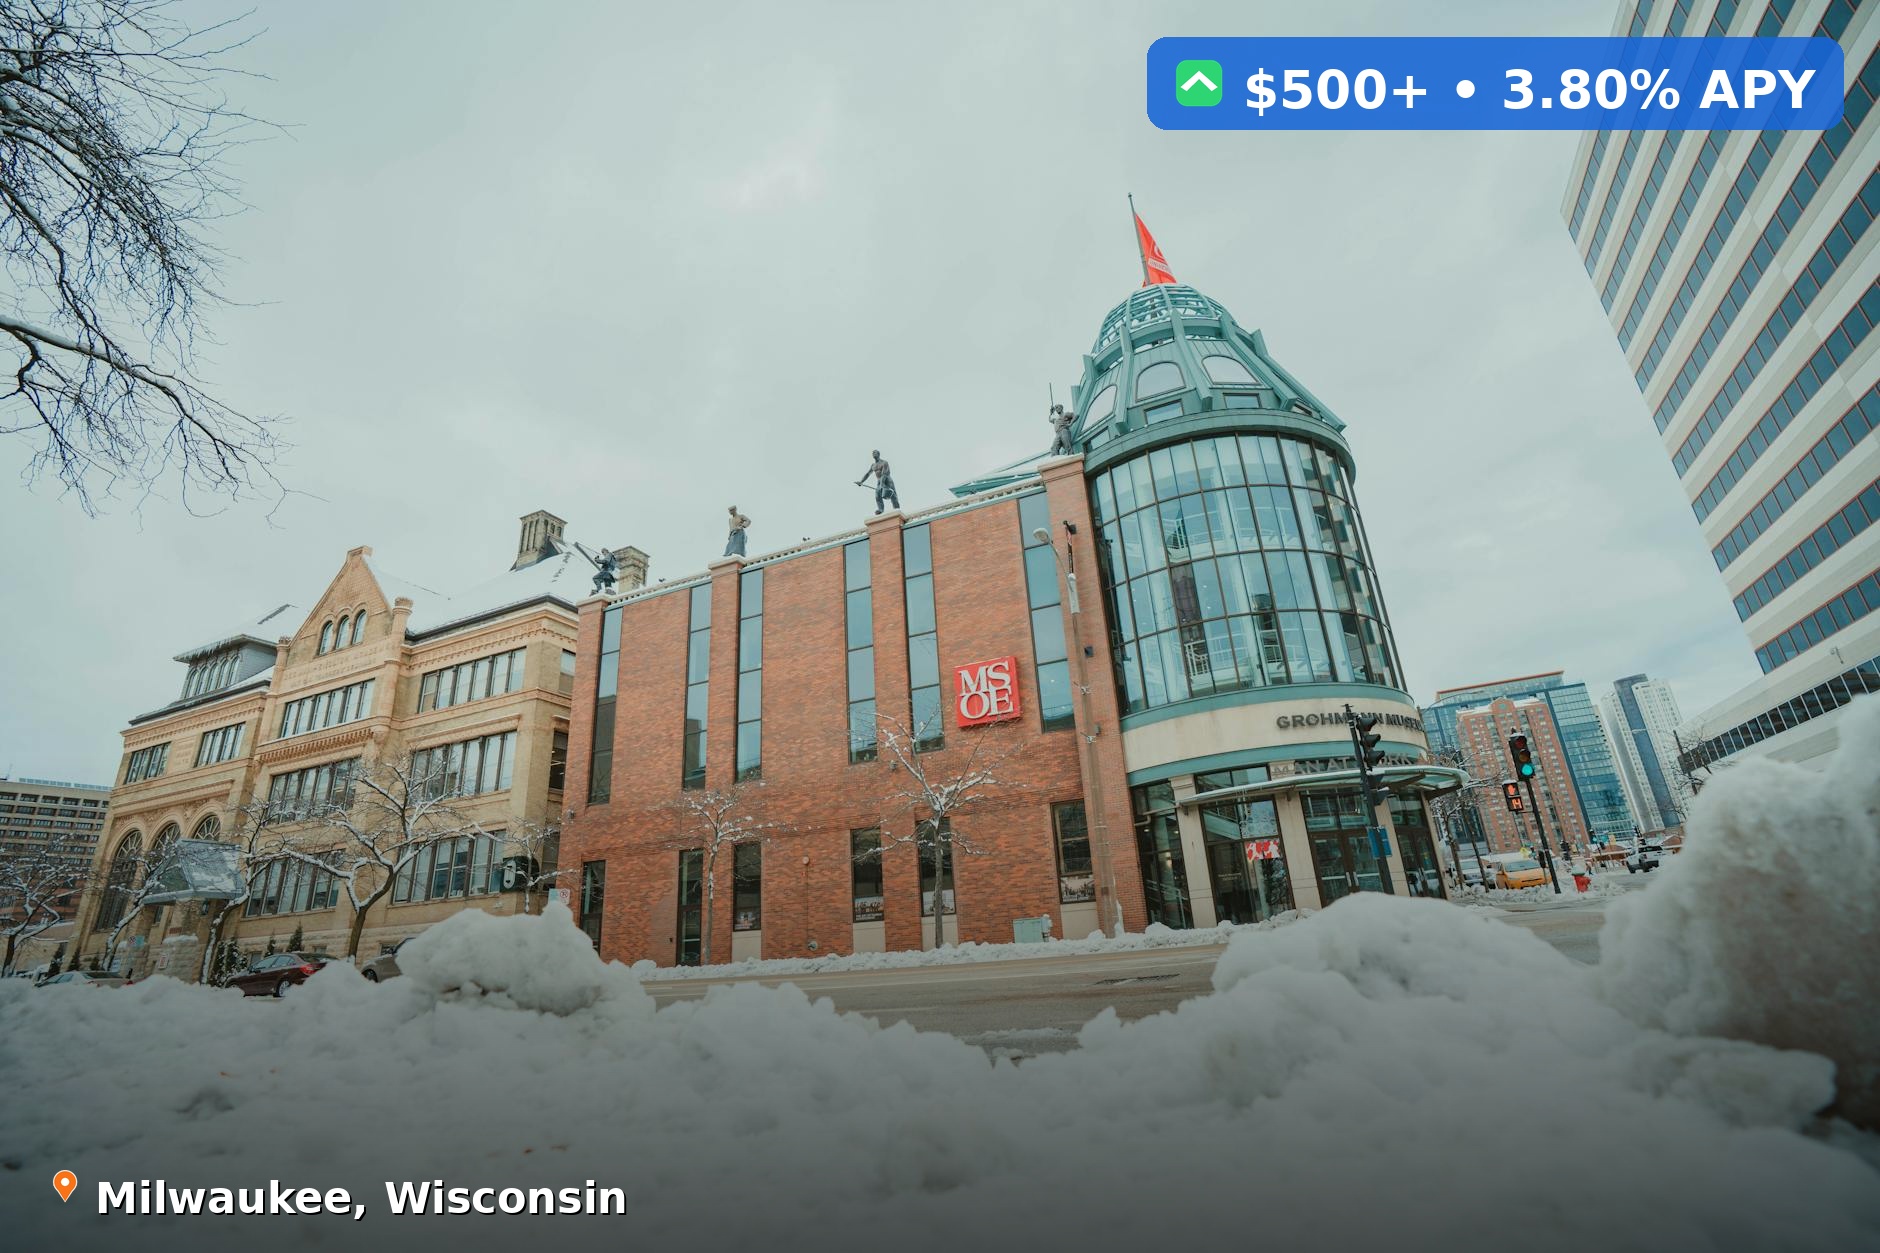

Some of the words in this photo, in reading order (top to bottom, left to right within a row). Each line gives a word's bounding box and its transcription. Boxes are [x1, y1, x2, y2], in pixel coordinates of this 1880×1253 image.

[1276, 712, 1385, 729] GROHMNN
[1385, 713, 1424, 733] MUSEU
[1327, 757, 1350, 772] AT
